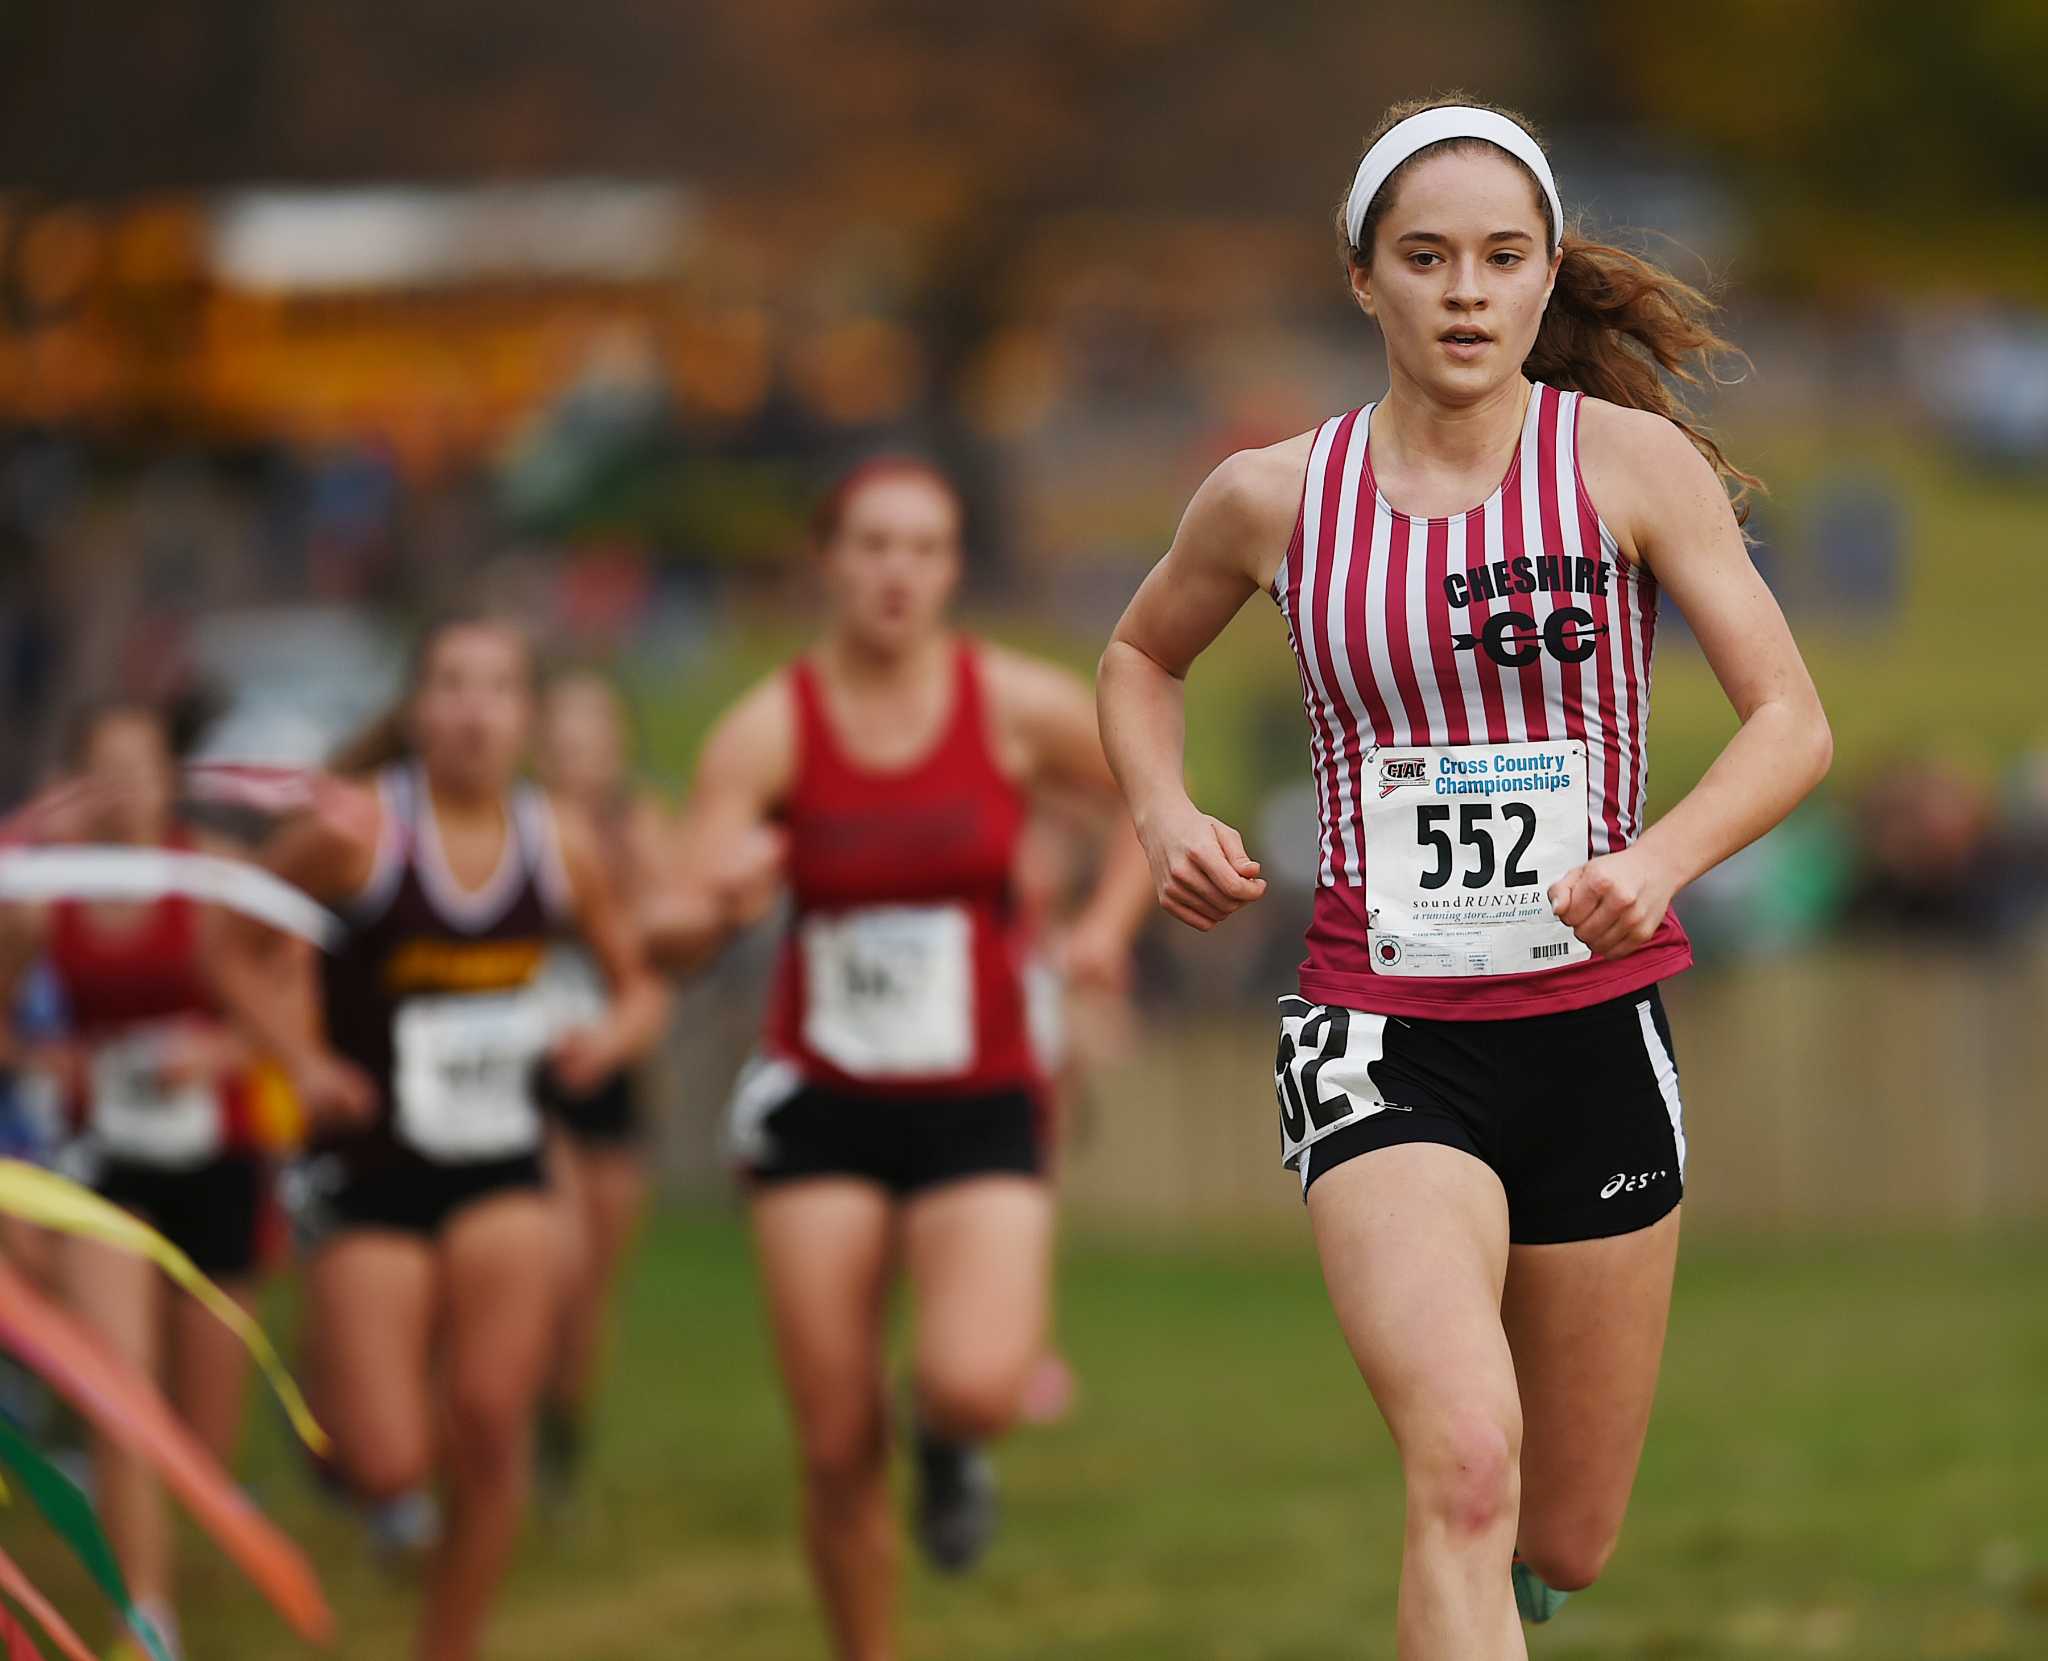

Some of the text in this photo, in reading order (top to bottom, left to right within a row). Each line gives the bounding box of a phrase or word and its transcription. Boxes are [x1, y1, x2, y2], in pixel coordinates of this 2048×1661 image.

[1443, 555, 1611, 608] CHESHIRE
[1482, 607, 1597, 667] CC
[1387, 762, 1426, 779] CIAC
[1439, 753, 1565, 775] Cross Country
[1435, 772, 1570, 797] Championships
[1416, 802, 1538, 889] 552
[1421, 911, 1461, 922] running
[1518, 907, 1543, 918] more
